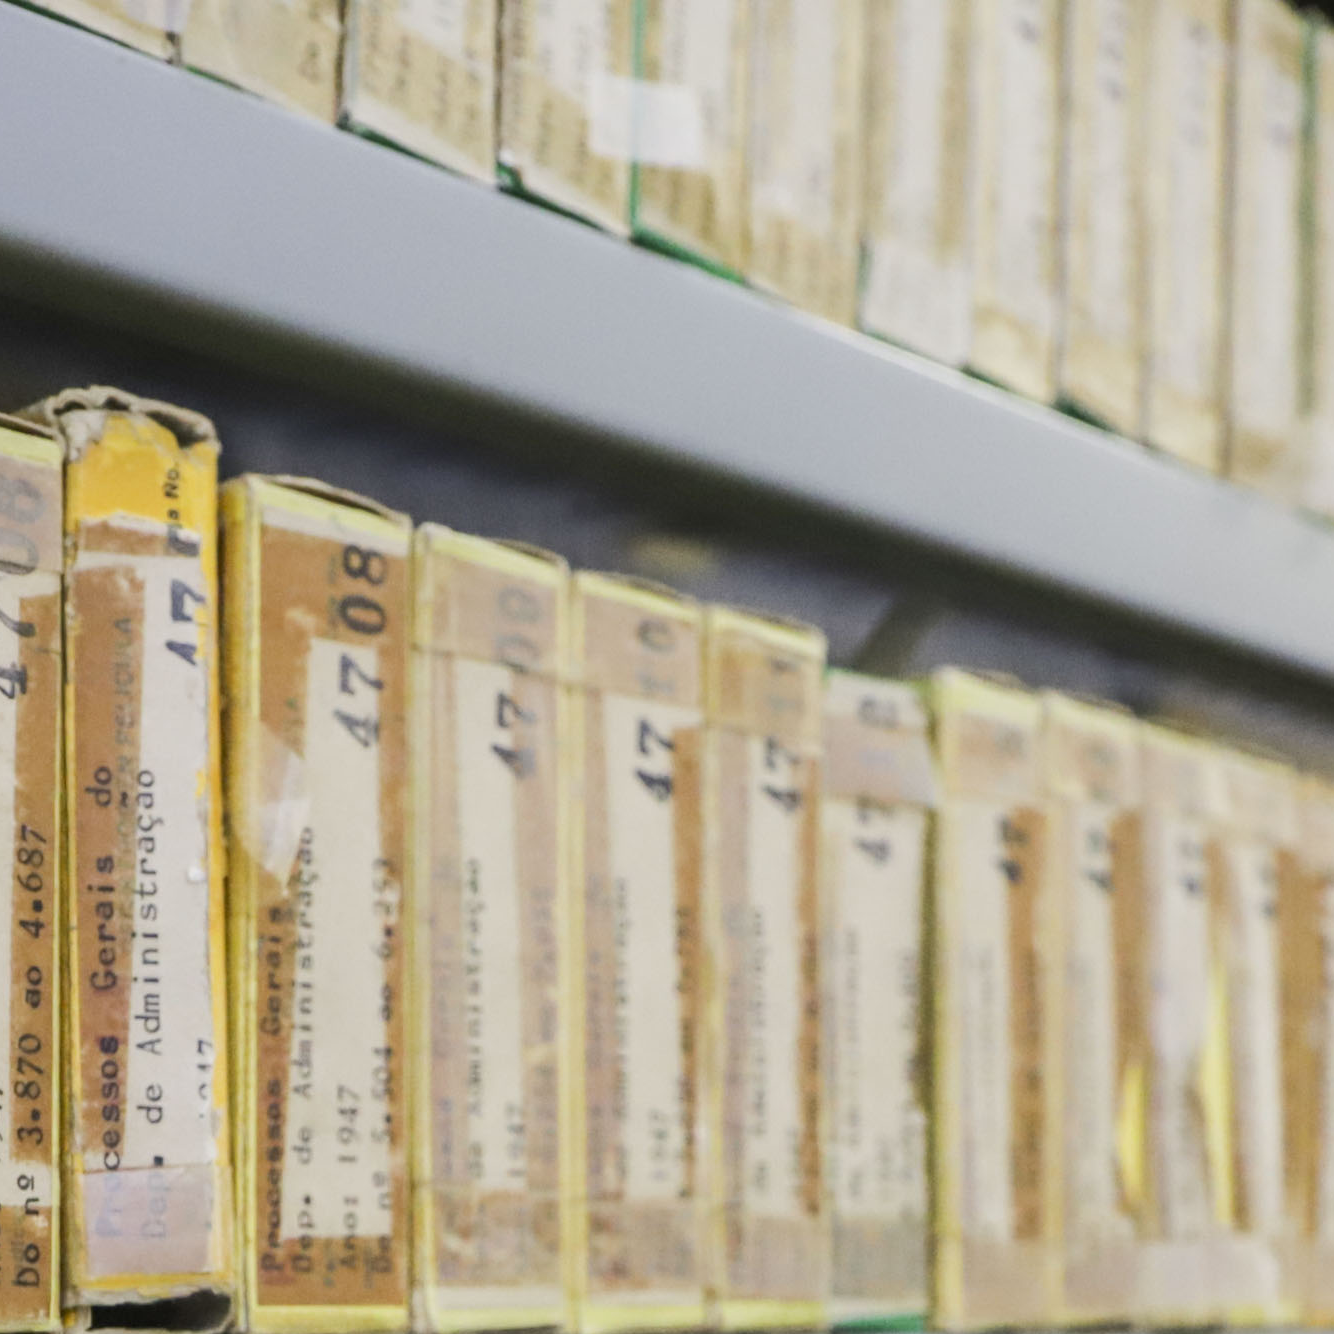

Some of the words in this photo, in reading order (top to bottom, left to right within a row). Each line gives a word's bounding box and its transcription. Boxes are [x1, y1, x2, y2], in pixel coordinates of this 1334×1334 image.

[83, 765, 119, 810] do
[15, 822, 47, 940] 4.687
[122, 768, 165, 1057] Administração
[87, 853, 119, 992] Gerais
[21, 964, 45, 1010] ao
[15, 1033, 47, 1147] 3.870
[133, 1082, 167, 1124] de
[333, 1082, 363, 1165] 1947
[91, 1034, 125, 1238] Processos
[289, 1124, 317, 1168] de
[15, 1172, 47, 1216] nº
[291, 1192, 321, 1277] Dep.
[335, 1193, 364, 1272] Ano:
[10, 1242, 44, 1290] Do
